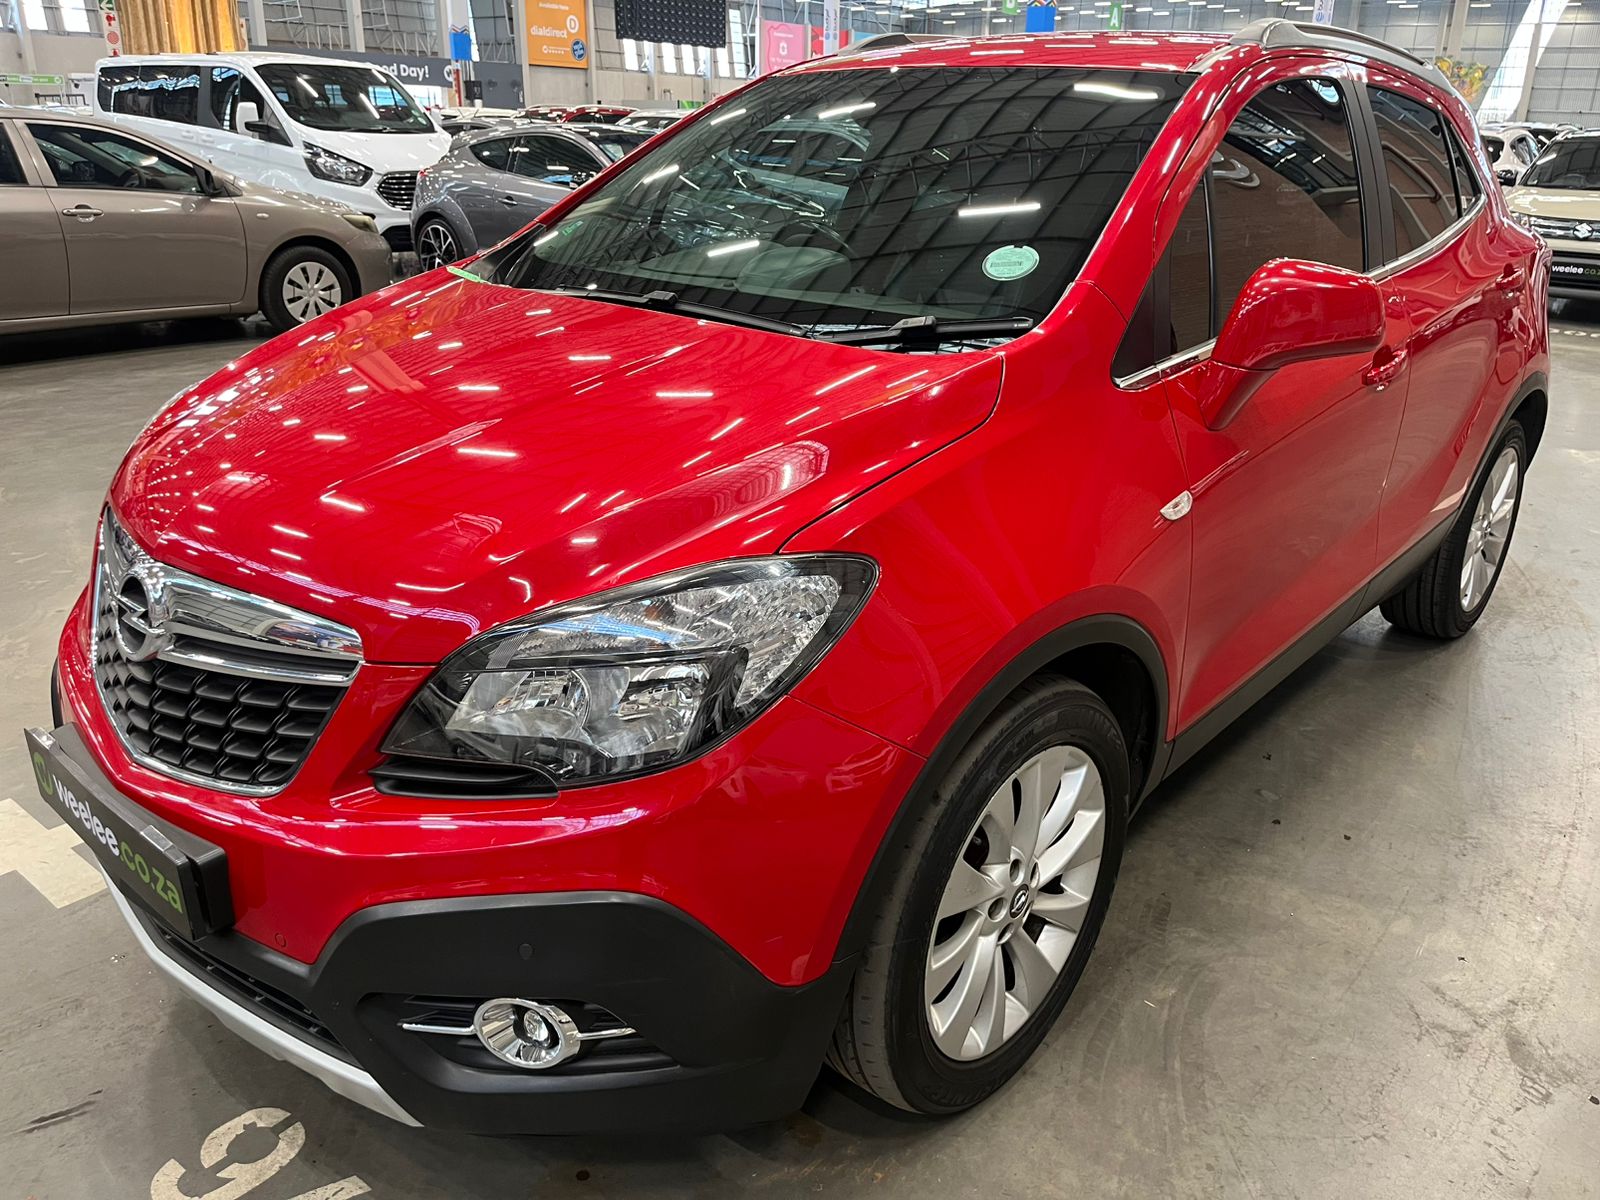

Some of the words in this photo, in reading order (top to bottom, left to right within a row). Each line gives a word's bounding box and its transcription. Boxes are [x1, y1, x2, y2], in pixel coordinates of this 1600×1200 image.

[1109, 7, 1119, 27] A
[400, 64, 429, 82] Day!
[53, 775, 183, 914] weelee.co.za
